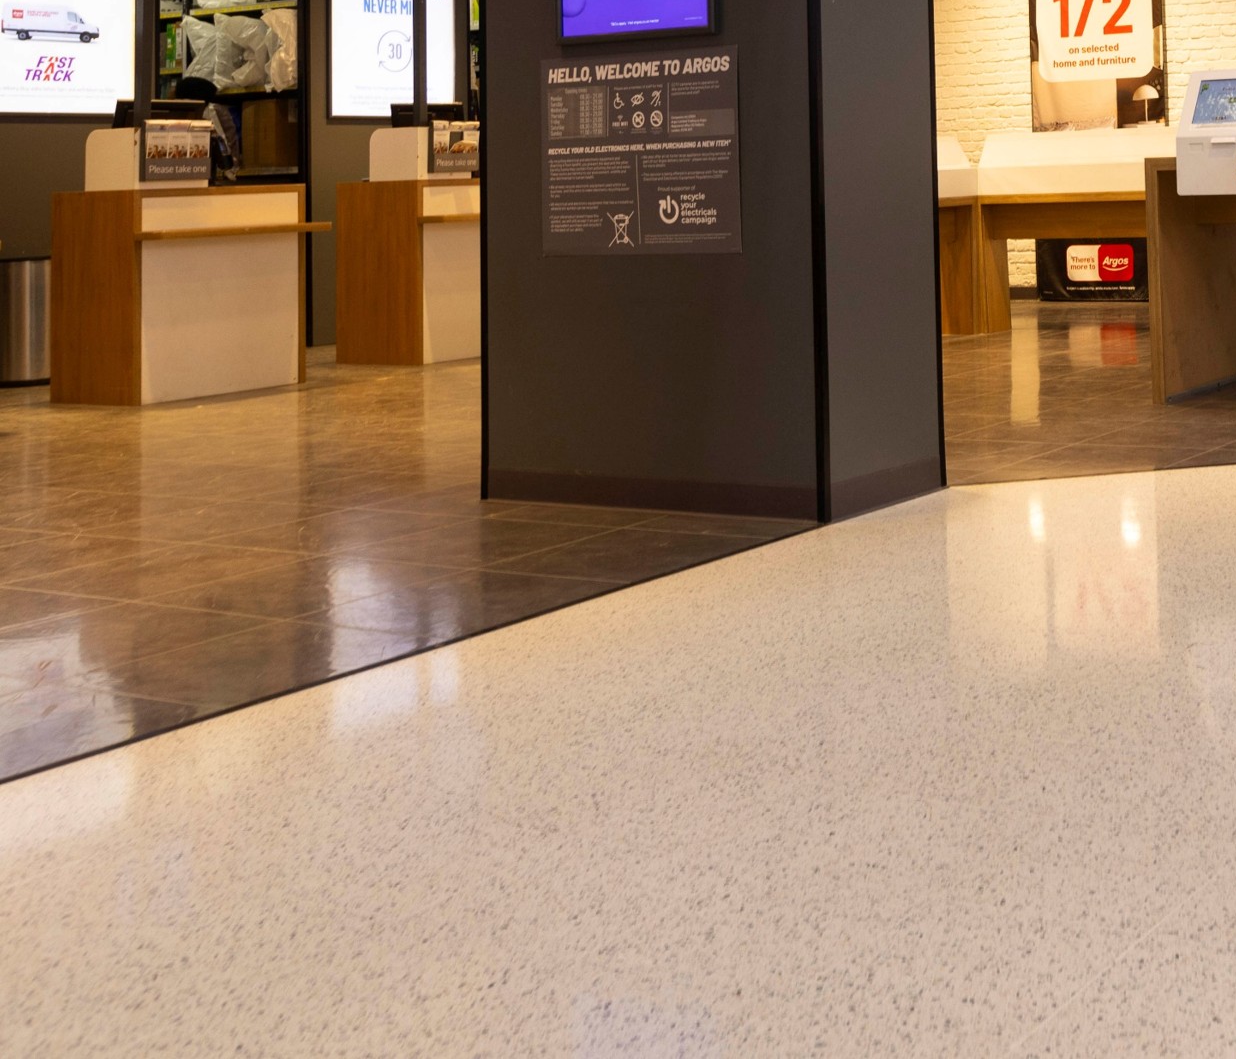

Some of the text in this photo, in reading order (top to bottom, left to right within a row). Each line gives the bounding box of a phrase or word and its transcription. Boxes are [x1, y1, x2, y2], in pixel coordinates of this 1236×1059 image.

[388, 42, 402, 60] 30
[1068, 43, 1120, 54] on selected
[1053, 56, 1136, 68] home and furniture
[548, 55, 730, 84] HELLO, WELCOME TO ARGOS
[548, 148, 570, 156] RECYCLE
[595, 144, 630, 153] ELECTRONICS
[646, 142, 662, 150] WHEN
[662, 140, 696, 150] PURCHASING
[697, 140, 702, 148] A
[702, 140, 716, 148] NEW
[148, 164, 206, 174] Please take one
[680, 192, 706, 202] recycle
[680, 202, 697, 210] your
[680, 208, 717, 217] electricals
[681, 216, 717, 225] campaign
[1070, 256, 1095, 264] There's
[1102, 256, 1129, 268] Argos
